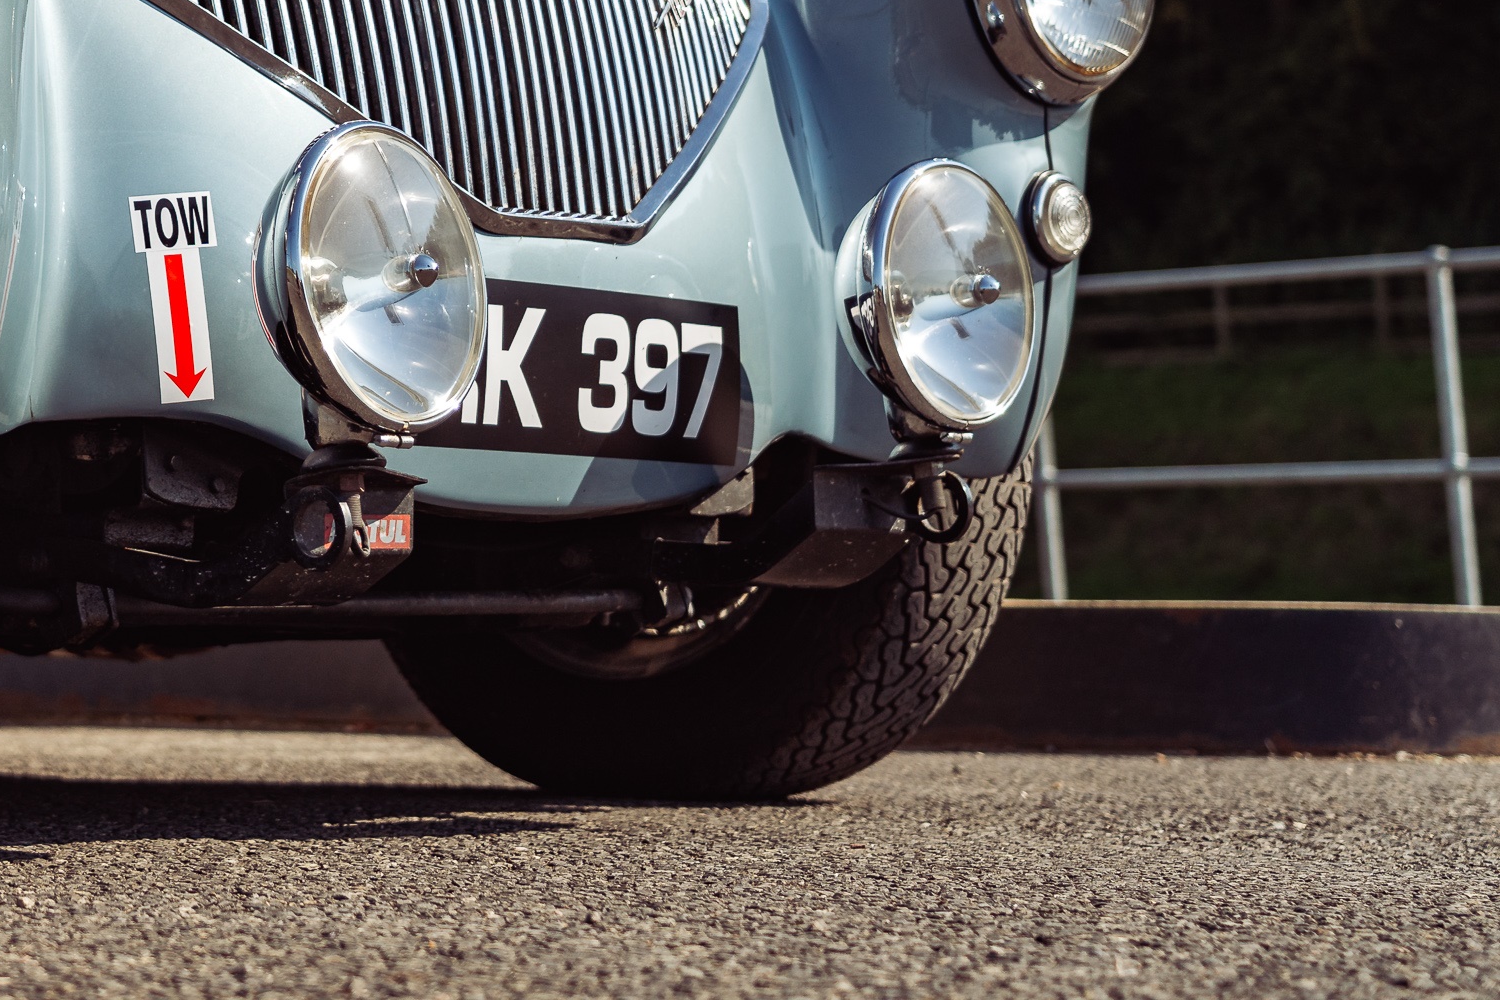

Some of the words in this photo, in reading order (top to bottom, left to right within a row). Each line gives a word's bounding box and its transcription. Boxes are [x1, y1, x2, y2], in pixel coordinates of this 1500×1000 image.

[133, 196, 209, 249] TOW
[461, 303, 546, 429] K
[578, 312, 722, 439] 397
